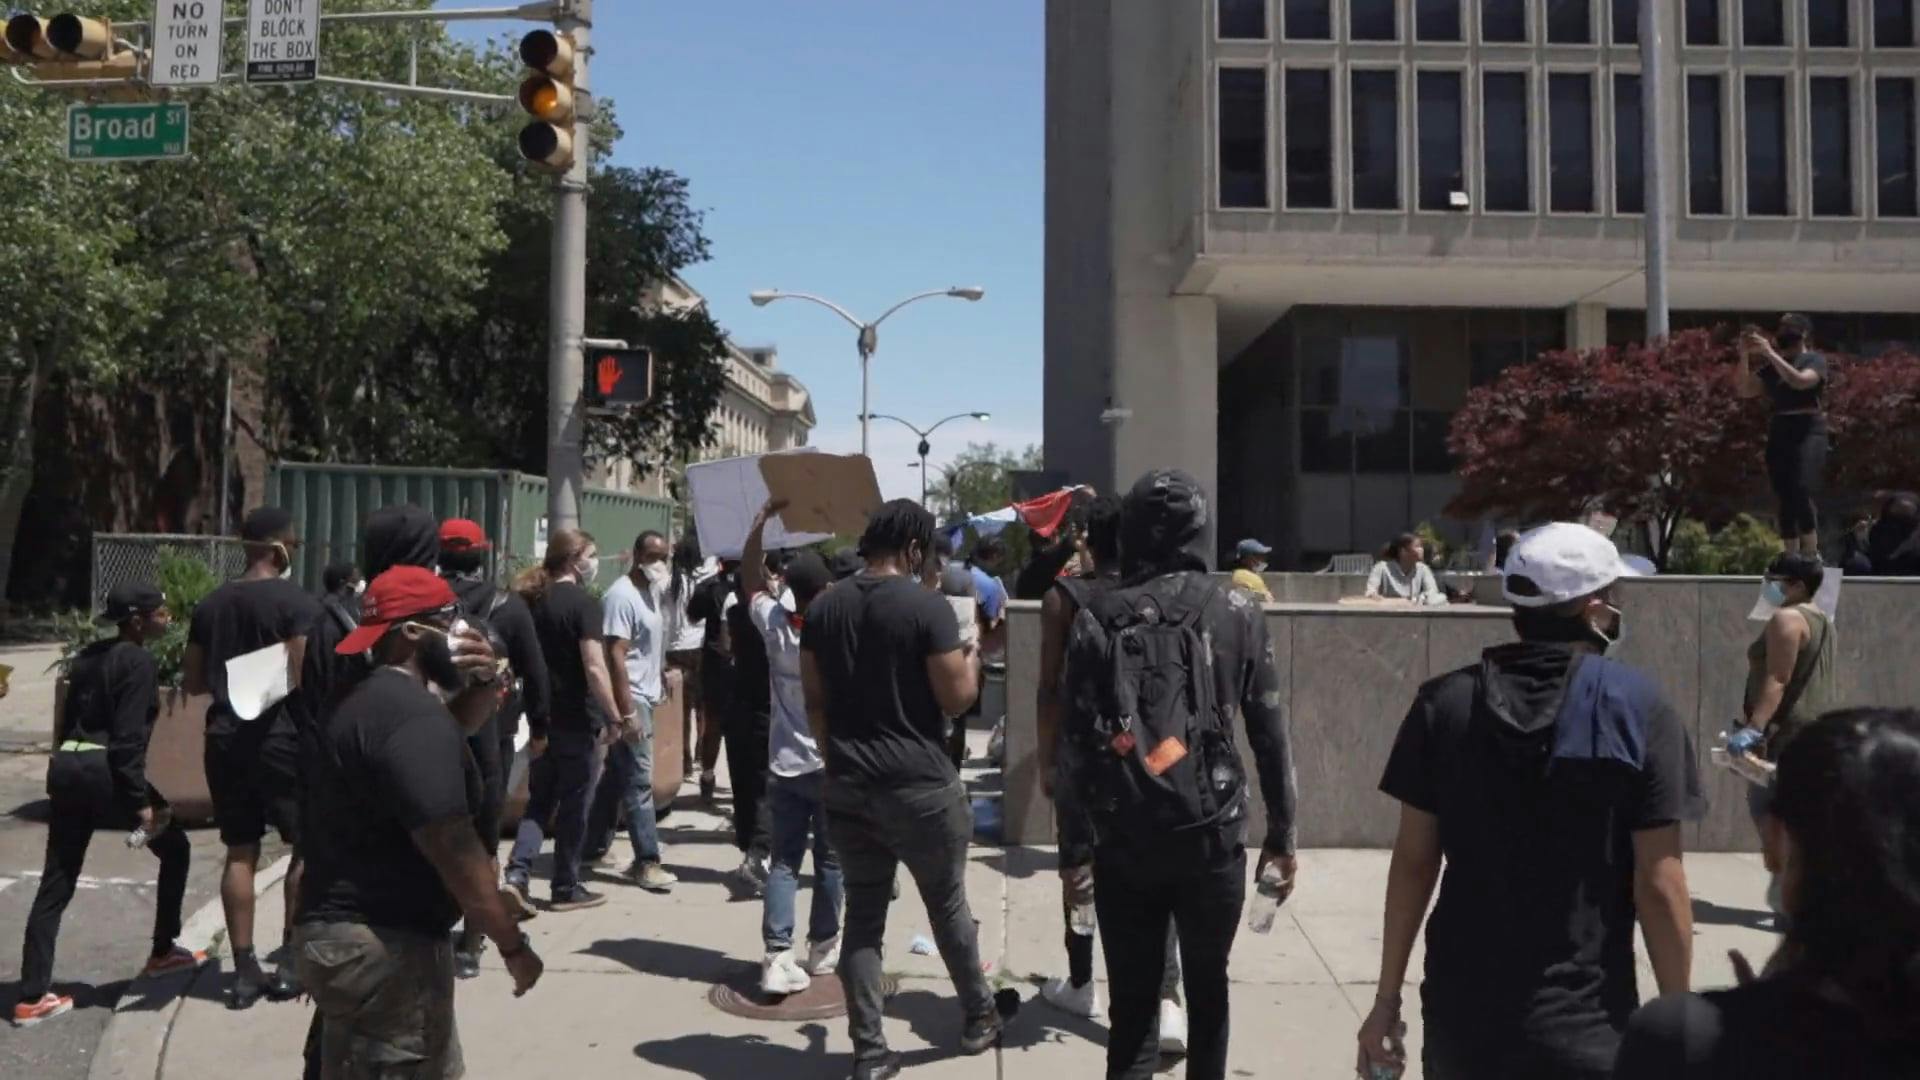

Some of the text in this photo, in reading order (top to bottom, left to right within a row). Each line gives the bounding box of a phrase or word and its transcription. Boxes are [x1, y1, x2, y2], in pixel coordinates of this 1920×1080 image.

[173, 2, 204, 19] NO
[168, 23, 208, 39] TURN
[261, 19, 306, 37] BLOCK
[175, 44, 198, 58] ON
[252, 40, 313, 59] THE BOX
[170, 64, 200, 79] RED
[74, 112, 156, 140] Broad
